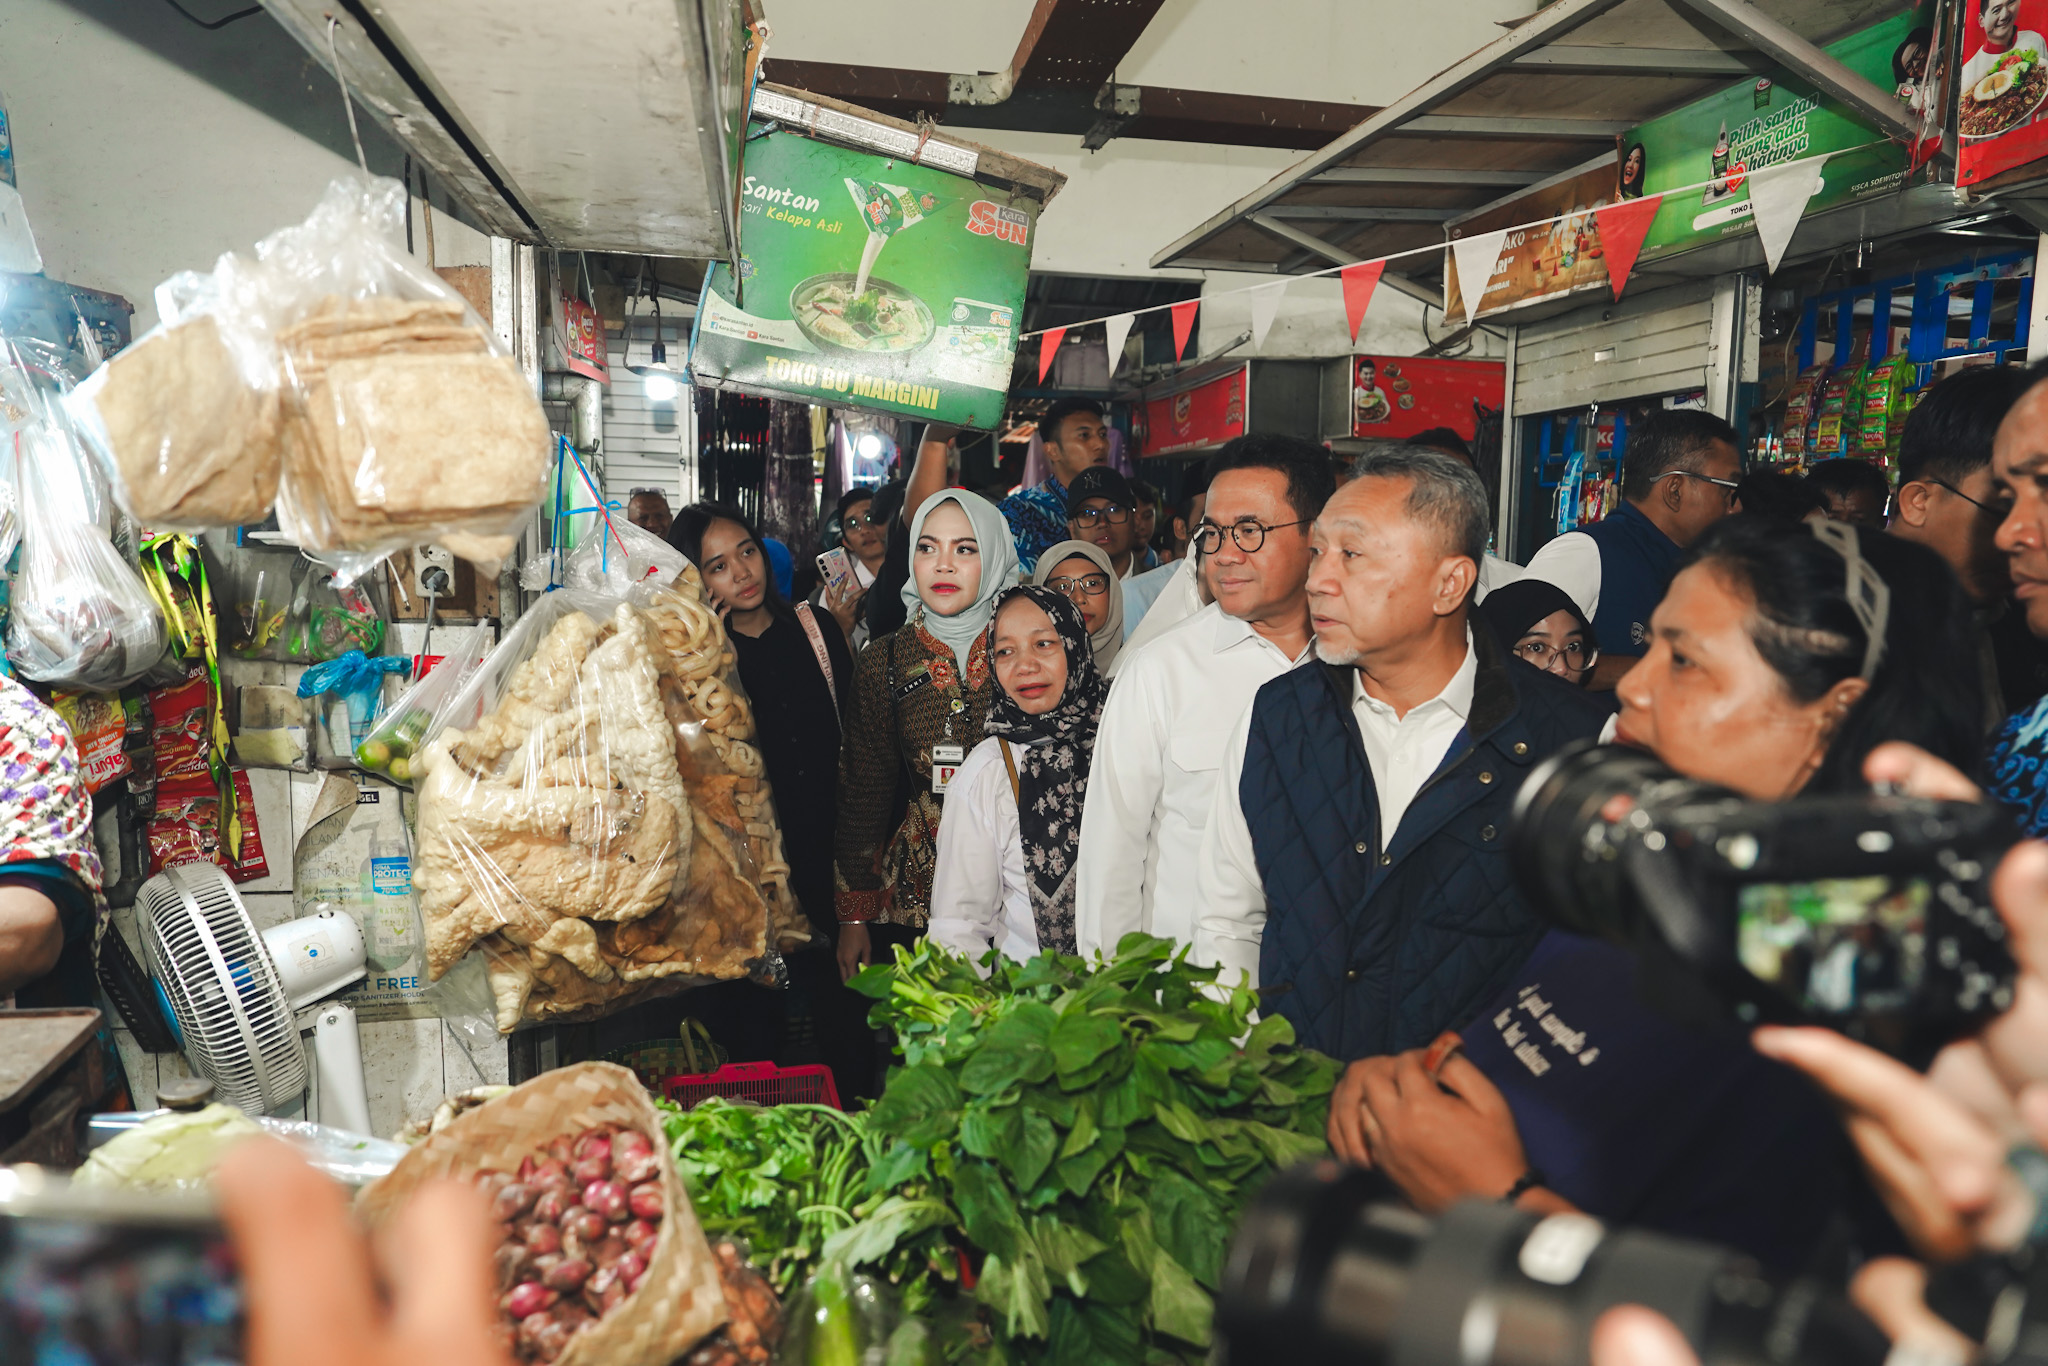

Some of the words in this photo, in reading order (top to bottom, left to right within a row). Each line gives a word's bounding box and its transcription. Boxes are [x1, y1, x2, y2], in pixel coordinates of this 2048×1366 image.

[1729, 117, 1761, 149] Pilih
[1763, 92, 1820, 134] santan
[1735, 131, 1774, 166] yang
[1775, 117, 1806, 145] ada
[1748, 133, 1809, 172] hatinya
[743, 176, 820, 213] Santan
[1851, 182, 1869, 192] SISCA
[1856, 185, 1888, 197] Professional
[1888, 180, 1902, 189] Chef
[742, 200, 763, 215] ari
[766, 211, 812, 228] Kelapa
[816, 218, 843, 234] Asli
[1731, 204, 1749, 215] TOKO
[965, 200, 1027, 246] SUN
[1721, 221, 1742, 235] PASAR
[765, 355, 818, 387] TOKO
[821, 367, 850, 393] BU
[853, 373, 940, 411] MARGINI
[815, 644, 835, 688] KIPLING
[301, 867, 355, 881] SENANG
[374, 869, 411, 878] PROTECT
[377, 976, 419, 991] FREE
[361, 993, 399, 1001] SANITIZER
